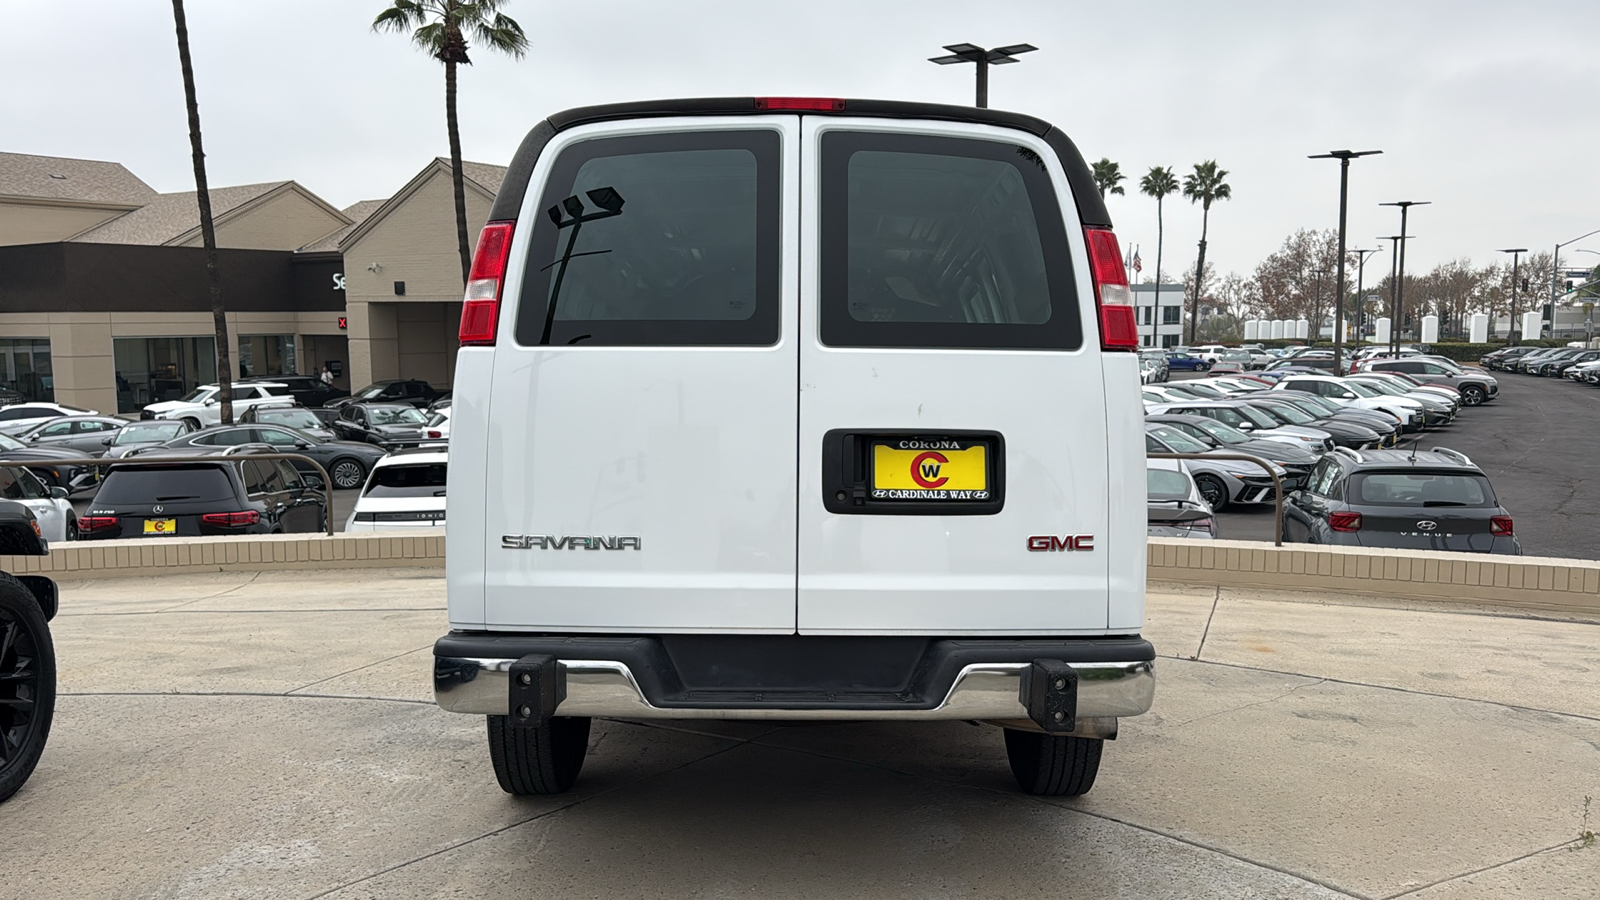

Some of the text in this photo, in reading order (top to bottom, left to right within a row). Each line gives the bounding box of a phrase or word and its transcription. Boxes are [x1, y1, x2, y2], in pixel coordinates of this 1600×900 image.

[899, 440, 961, 449] CORONA
[921, 463, 942, 478] W
[888, 490, 973, 499] CARDINALE WAY
[501, 533, 642, 551] SAVANA
[1026, 533, 1094, 552] GMC
